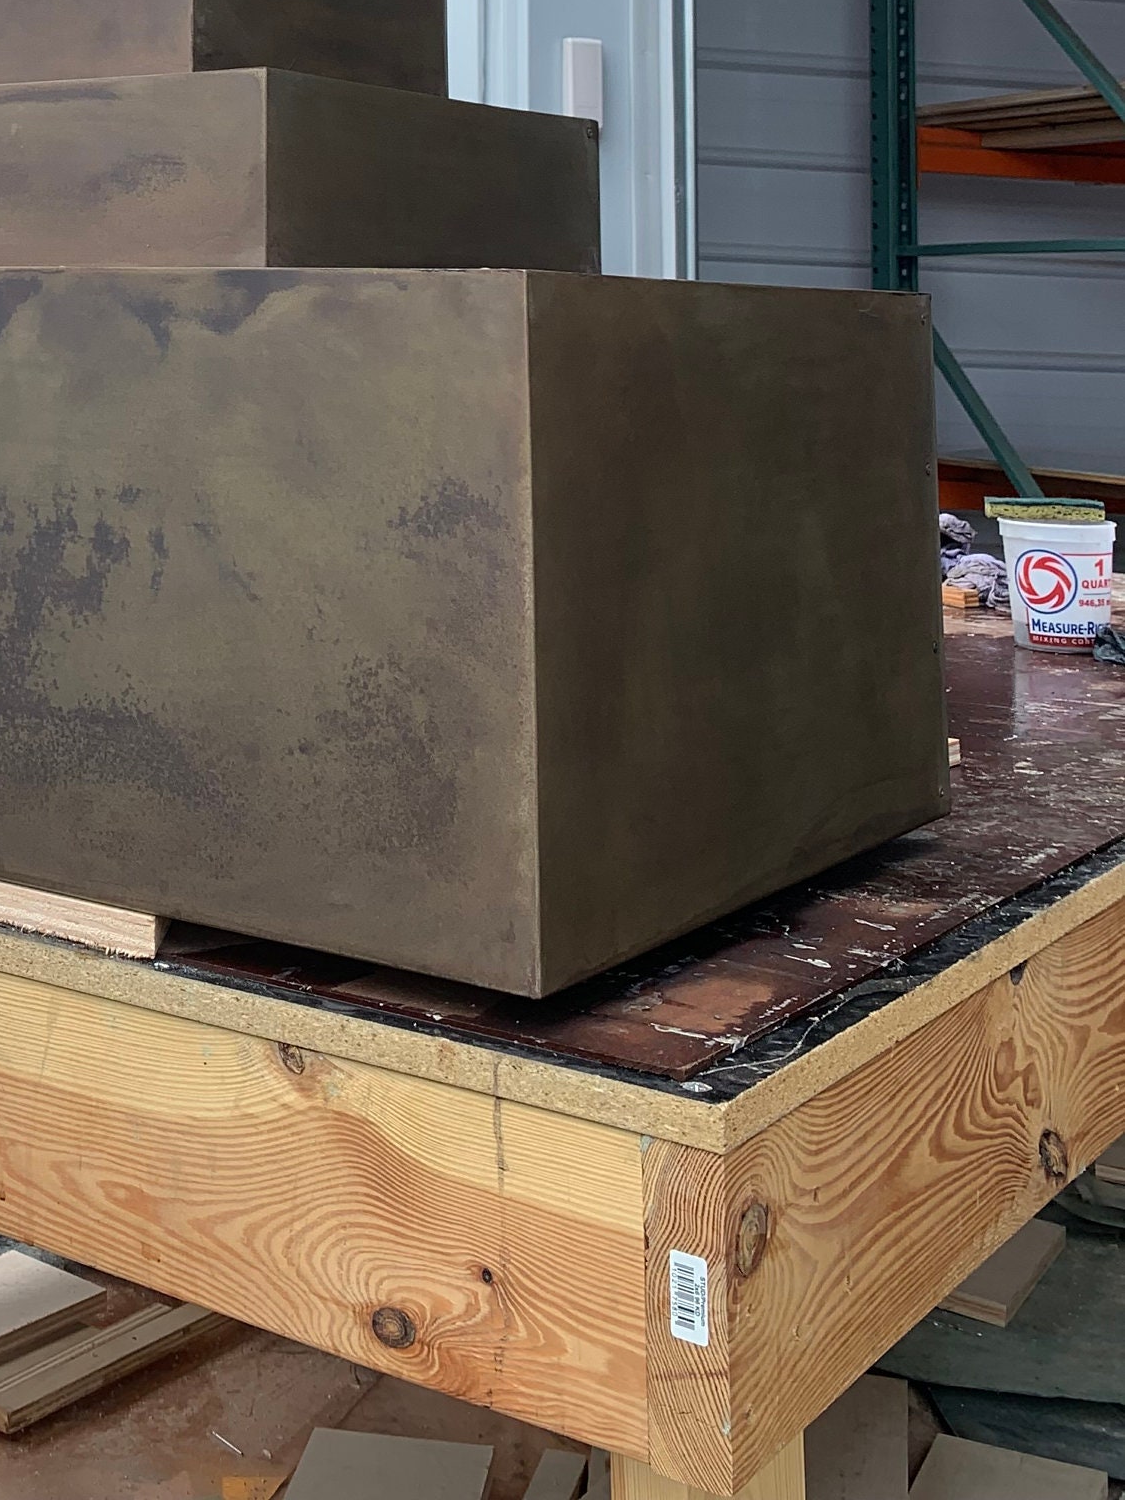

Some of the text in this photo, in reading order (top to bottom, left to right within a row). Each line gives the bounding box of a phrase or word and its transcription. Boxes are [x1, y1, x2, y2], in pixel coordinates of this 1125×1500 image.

[1094, 558, 1104, 577] 1
[1031, 618, 1111, 636] MEASURE-RI
[1032, 635, 1067, 645] MIXING
